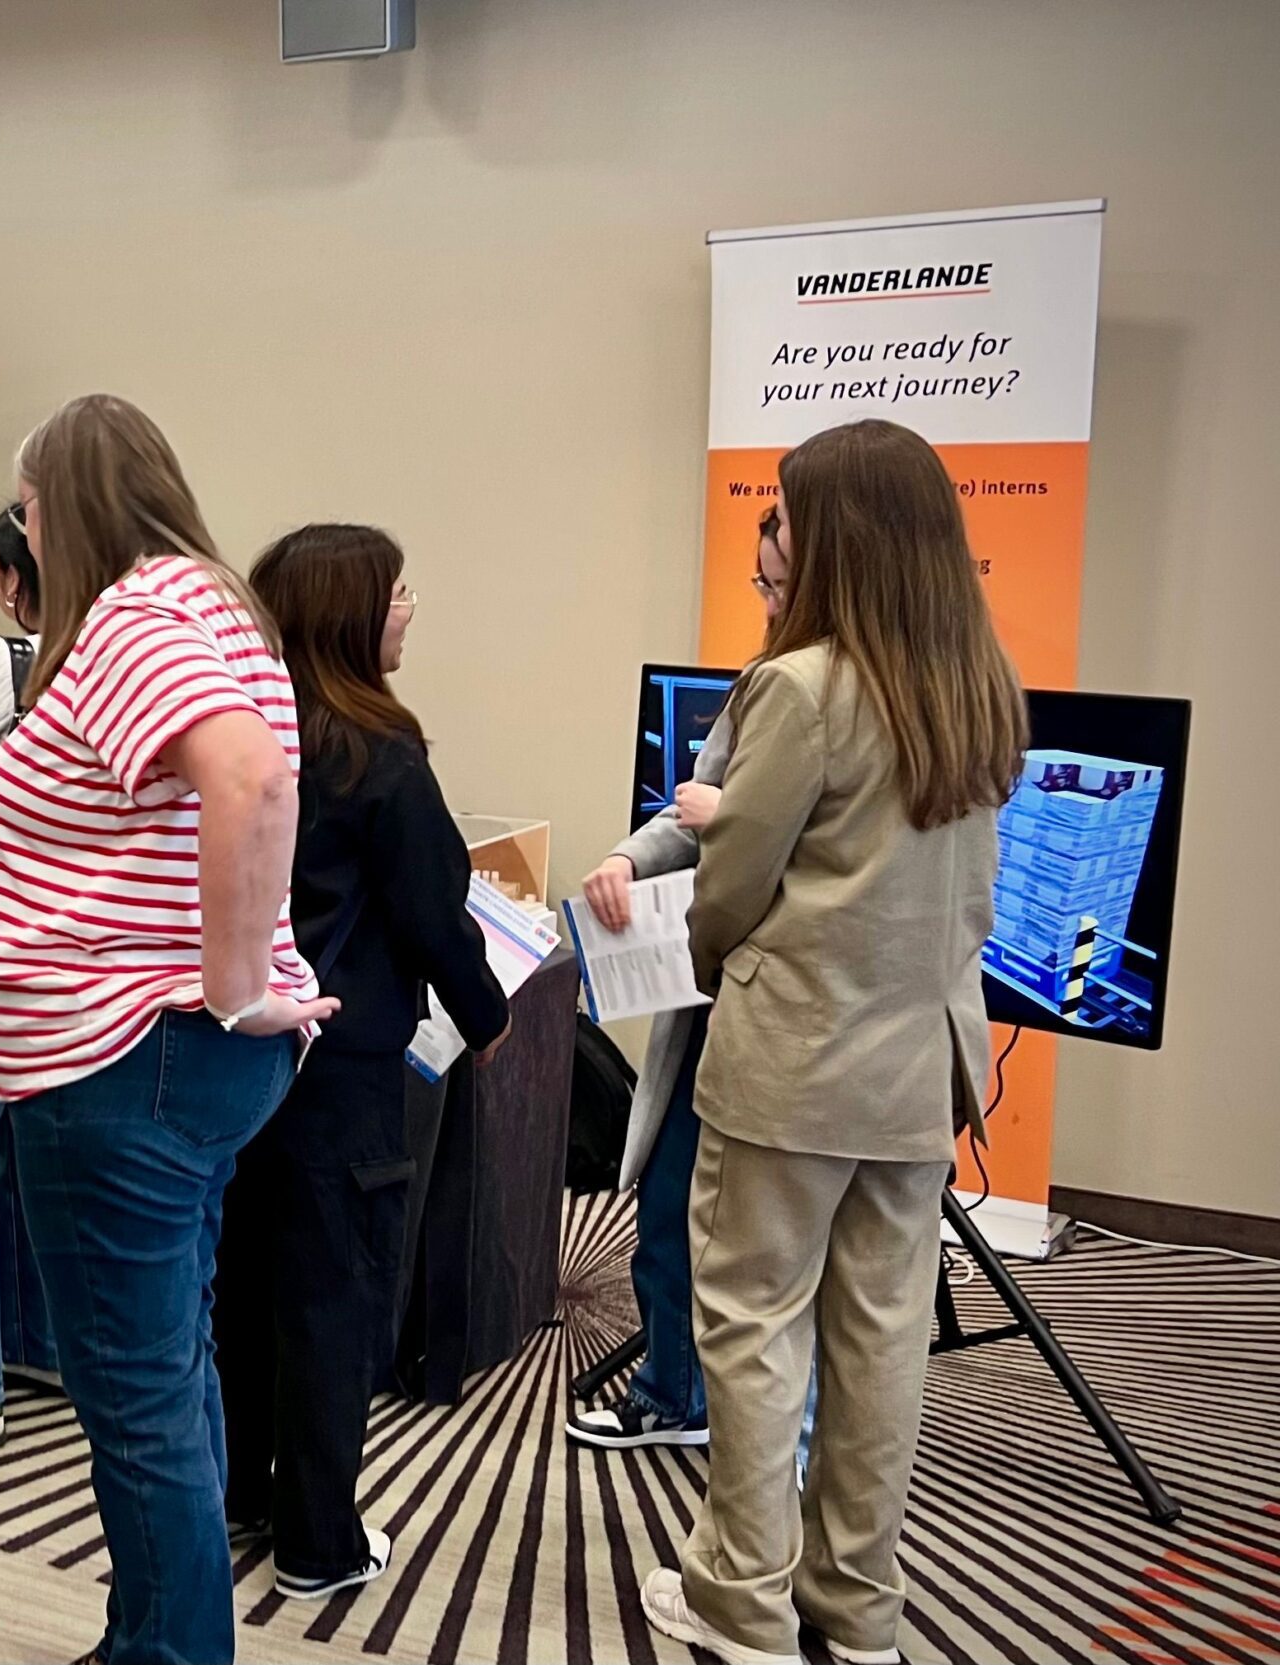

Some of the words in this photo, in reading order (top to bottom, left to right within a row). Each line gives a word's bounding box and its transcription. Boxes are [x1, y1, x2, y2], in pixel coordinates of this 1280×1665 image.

[797, 262, 993, 297] VANDERLANDE
[771, 342, 818, 366] Are
[823, 344, 875, 370] you
[882, 333, 964, 364] ready
[968, 331, 1013, 363] for
[761, 382, 825, 408] your
[830, 375, 888, 400] next
[891, 369, 1021, 404] journey?
[729, 482, 751, 496] We
[982, 479, 1048, 496] interns
